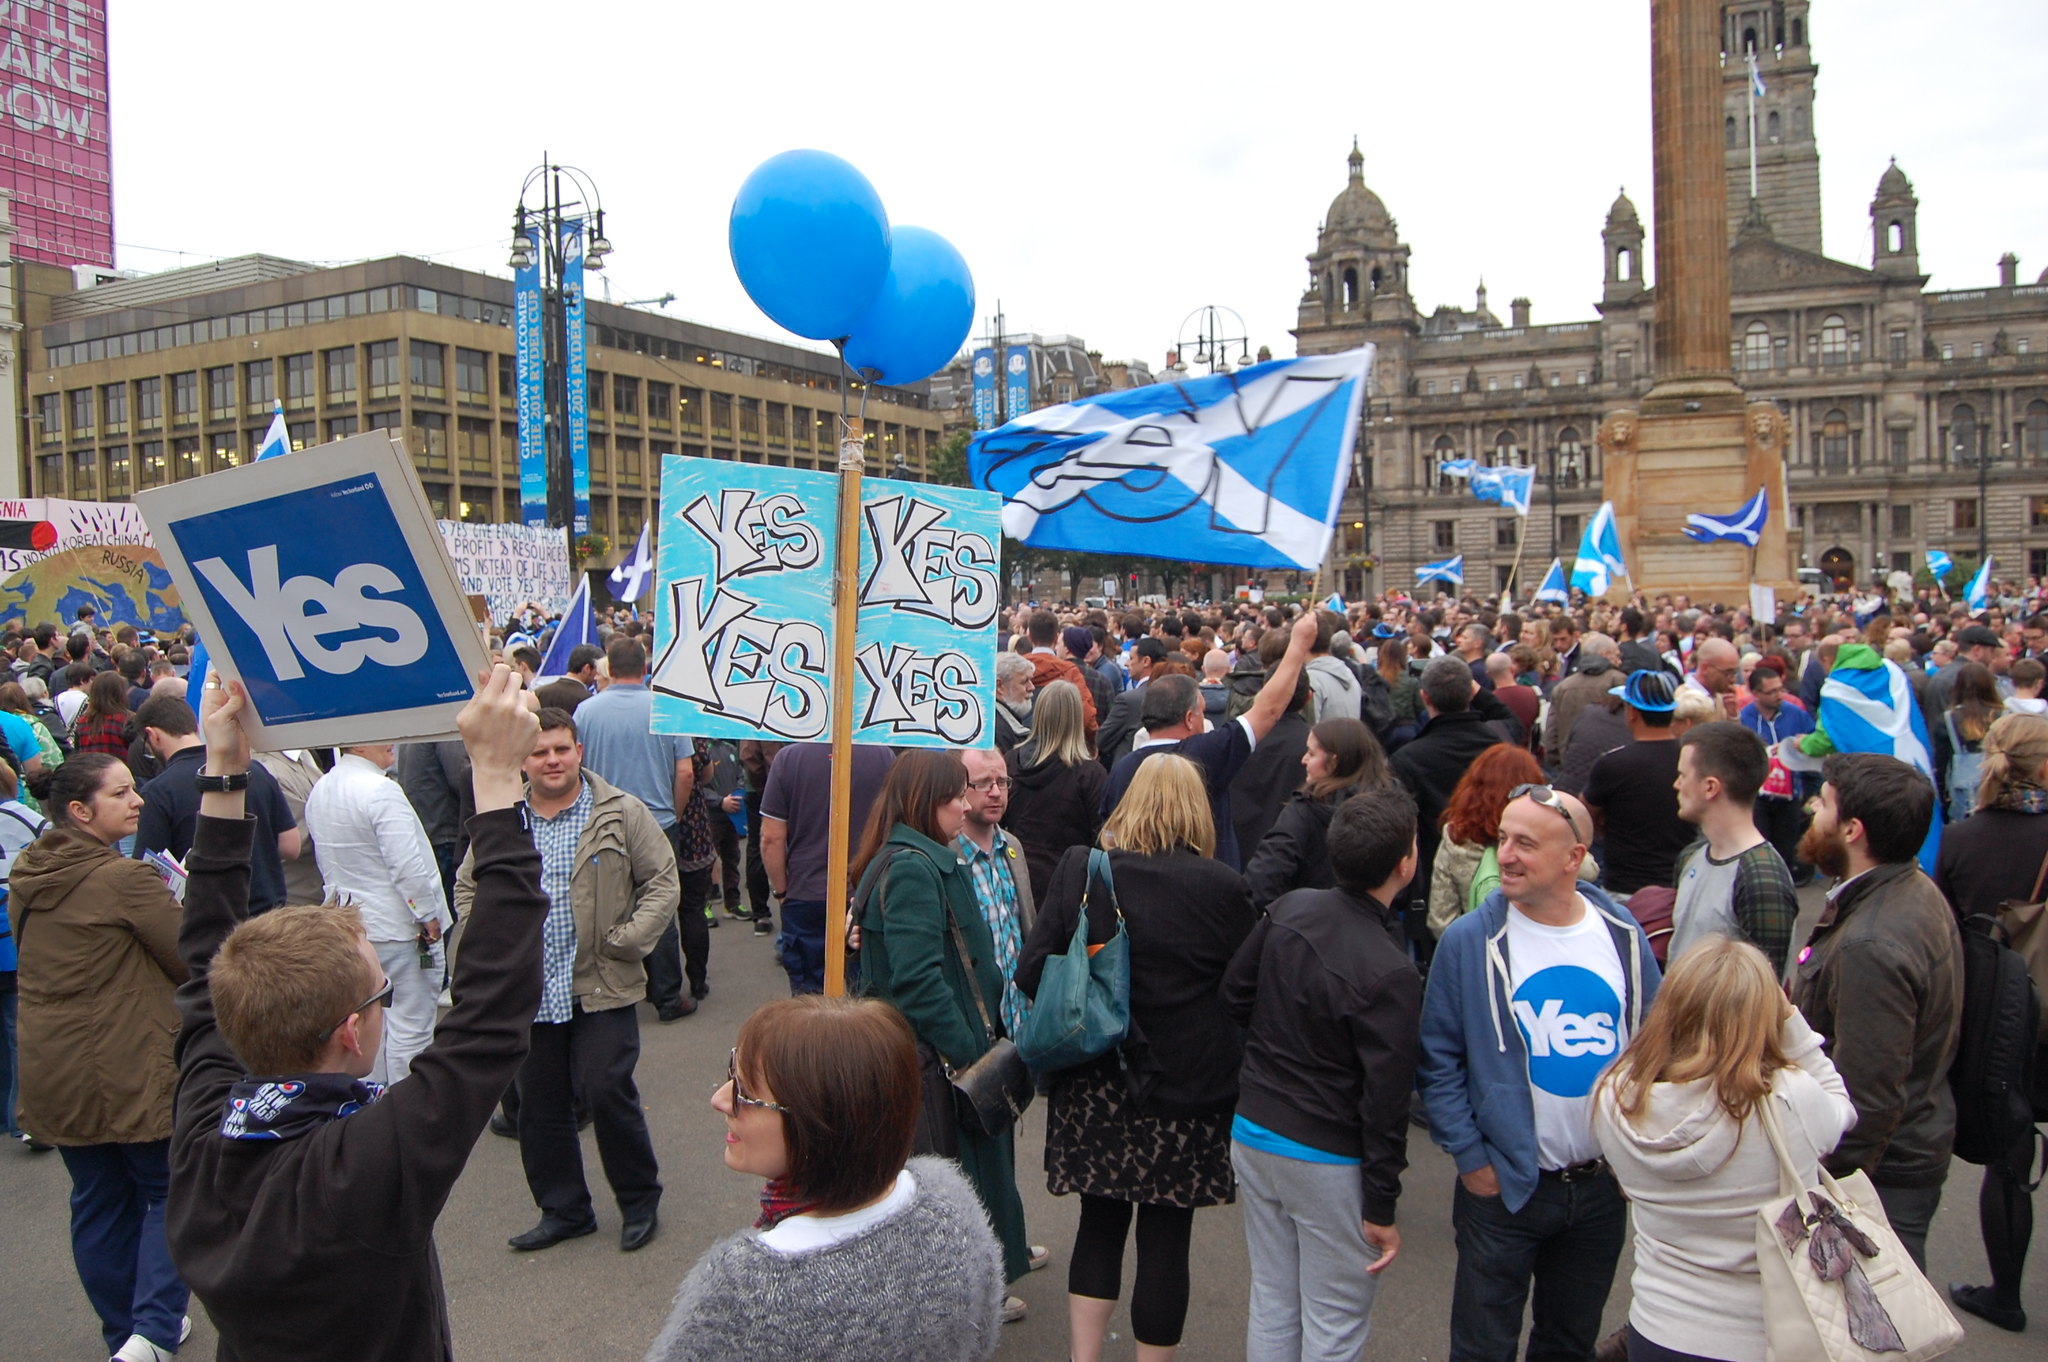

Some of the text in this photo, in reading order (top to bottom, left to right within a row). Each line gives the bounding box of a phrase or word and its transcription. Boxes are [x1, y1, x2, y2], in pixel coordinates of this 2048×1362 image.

[0, 82, 92, 146] OW
[518, 291, 530, 459] GLASGOW WELCOMES
[528, 290, 542, 458] THE 2014 RYDER CUP
[570, 281, 584, 453] THE 2014 RYDER CUP
[23, 541, 60, 567] NORTH
[102, 550, 144, 584] RUSSIA
[451, 522, 467, 537] YES
[454, 538, 493, 556] PROFIT
[512, 540, 568, 562] RESOURCES
[475, 558, 512, 576] INSTEAD
[516, 560, 528, 577] OF
[532, 561, 547, 580] LIFE
[559, 564, 569, 580] US
[683, 490, 819, 585] YES
[859, 495, 999, 629] YES
[193, 544, 429, 681] Yes
[461, 576, 483, 592] AND
[488, 577, 512, 593] VOTE
[517, 577, 534, 593] YES
[652, 579, 829, 739] YES
[855, 642, 982, 745] YES
[1513, 999, 1617, 1058] Yes
